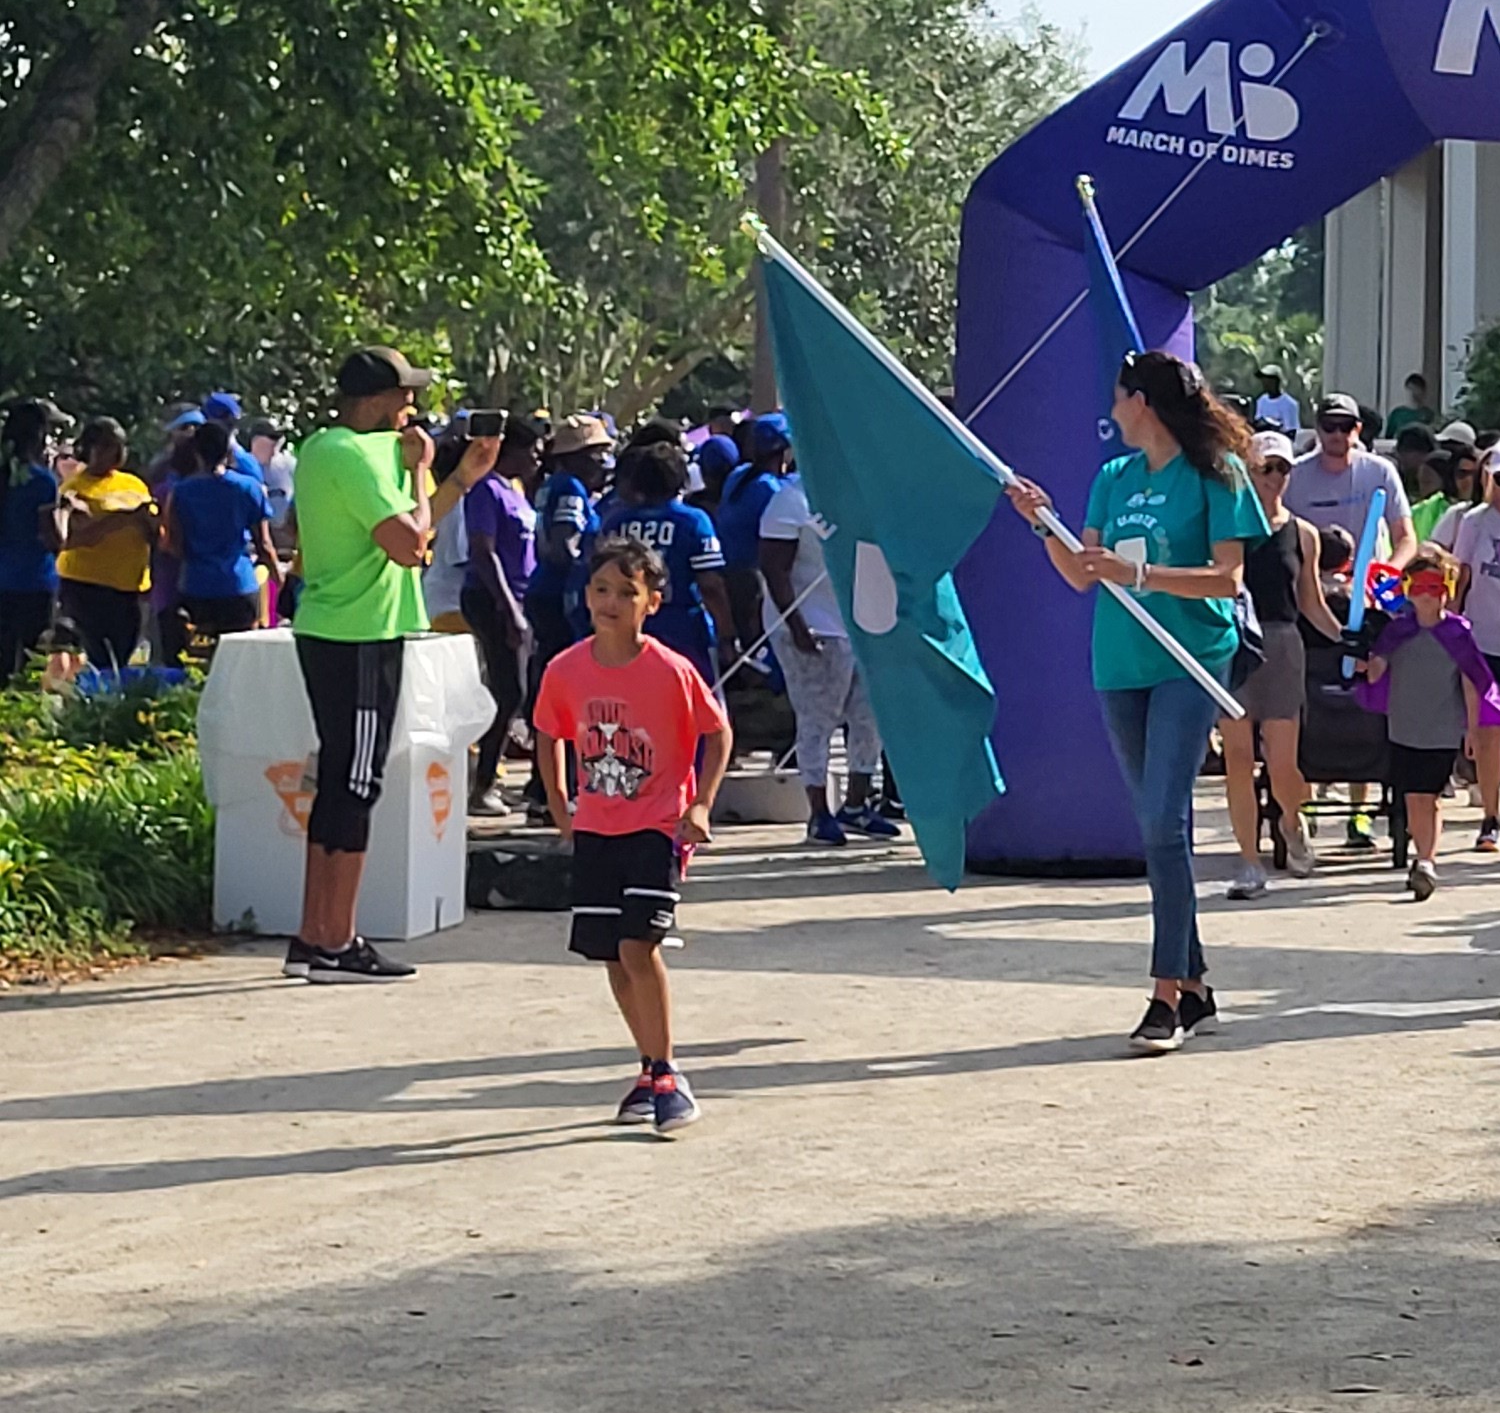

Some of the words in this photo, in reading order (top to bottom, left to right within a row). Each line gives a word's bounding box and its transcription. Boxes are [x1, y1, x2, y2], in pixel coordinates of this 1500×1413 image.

[1106, 125, 1185, 155] MARCH
[1188, 139, 1219, 160] OF
[1222, 145, 1295, 169] DIMES
[620, 520, 676, 546] 1920
